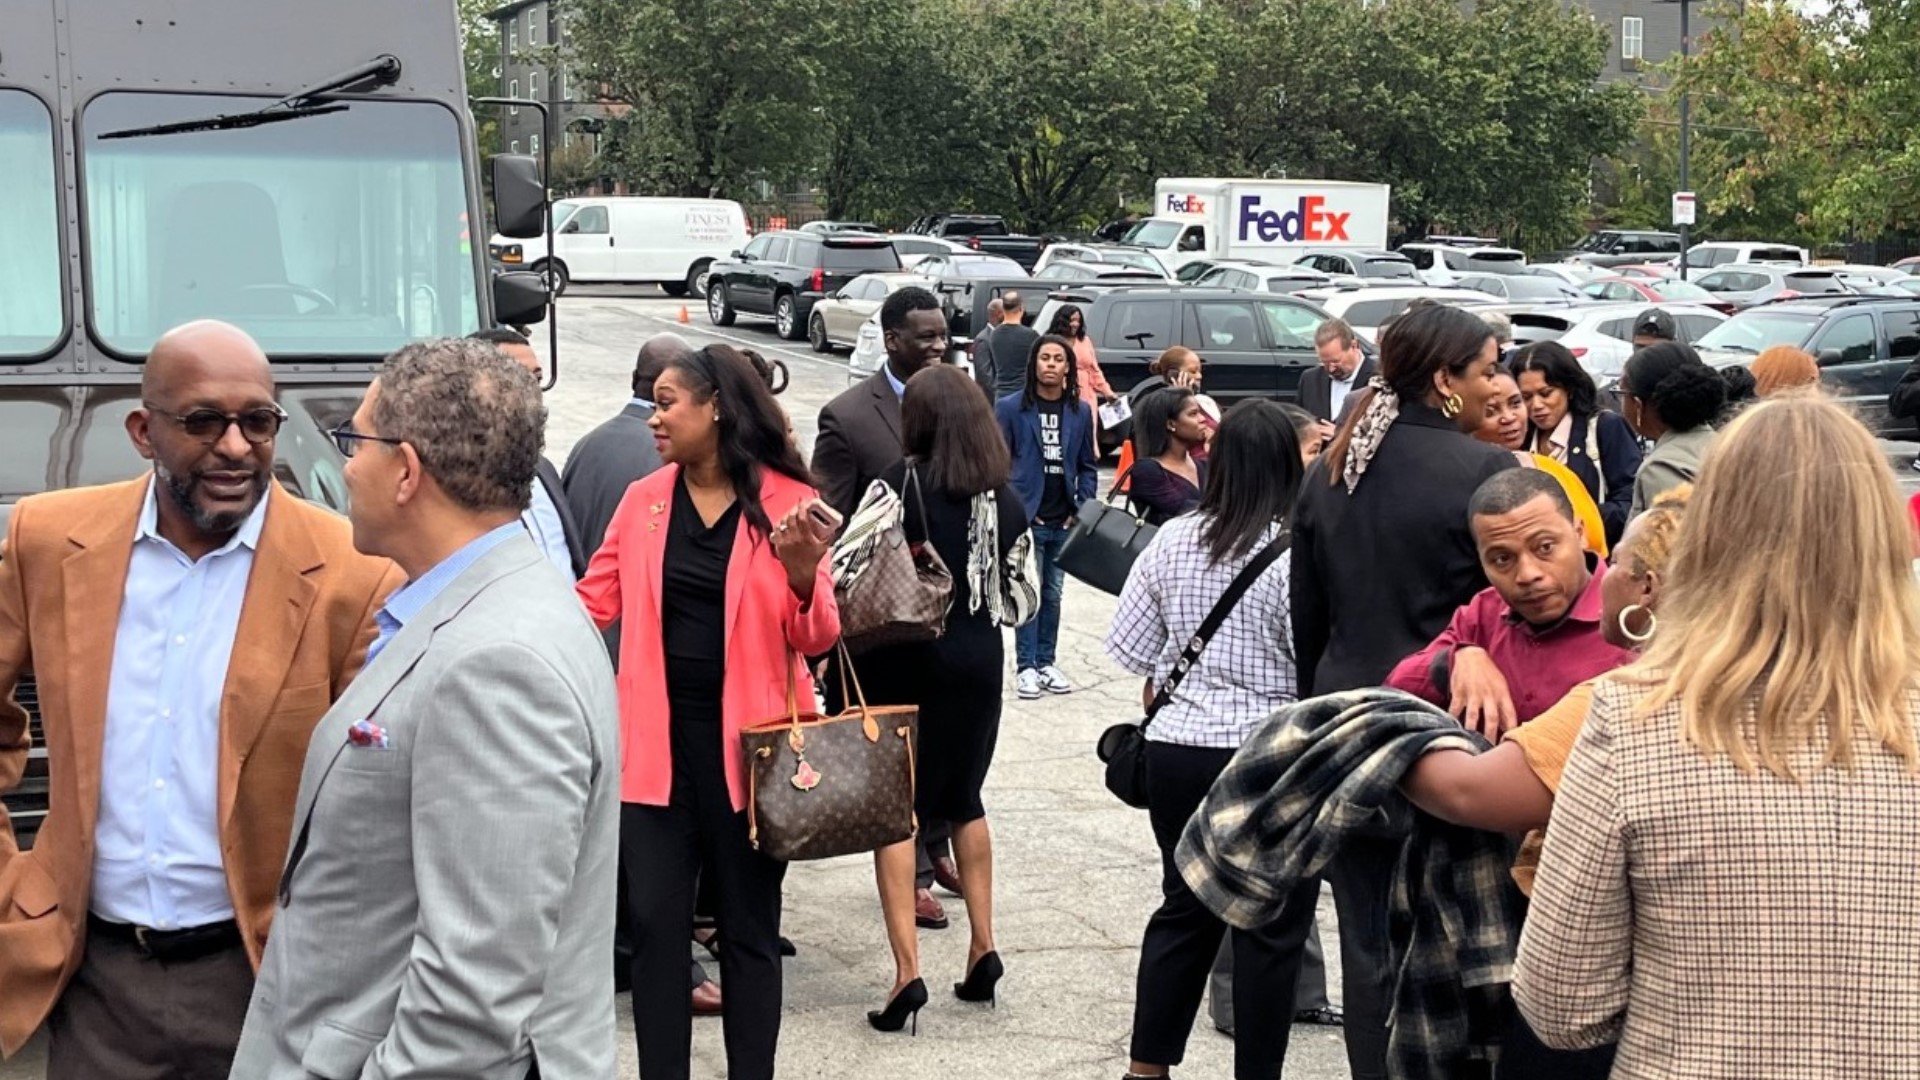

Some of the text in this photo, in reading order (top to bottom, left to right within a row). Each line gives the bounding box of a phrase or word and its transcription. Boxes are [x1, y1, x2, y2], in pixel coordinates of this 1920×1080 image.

[1167, 194, 1205, 213] FedEx
[684, 213, 730, 225] FINEST
[1239, 196, 1350, 242] FedEx
